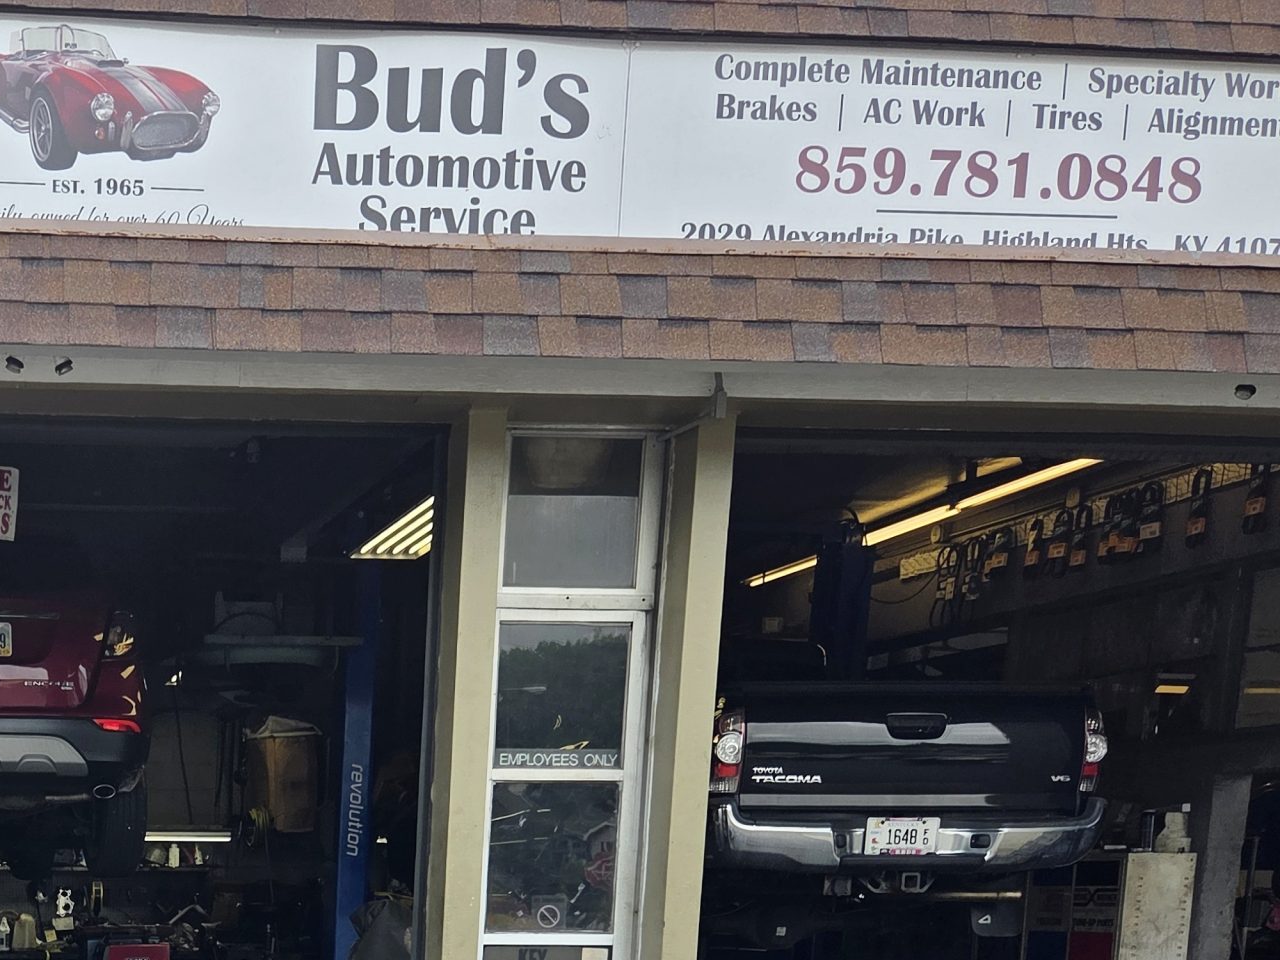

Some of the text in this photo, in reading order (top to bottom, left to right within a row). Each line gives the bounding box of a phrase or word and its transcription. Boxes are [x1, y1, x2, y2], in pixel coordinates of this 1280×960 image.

[313, 43, 590, 140] Bud's
[714, 53, 850, 88] Complete
[860, 58, 1042, 91] Maintenance
[1088, 67, 1216, 102] Specialty
[715, 93, 1280, 140] Brakes AC Work Tires Alignmen
[51, 177, 145, 197] EST. 1965
[311, 142, 587, 193] Automotive
[795, 145, 1203, 204] 859.781.0848
[358, 194, 536, 235] Service
[499, 752, 618, 767] EMPLOYEES ONLY
[752, 774, 822, 784] TACOMA
[346, 763, 364, 857] revolution
[886, 828, 918, 845] 1648
